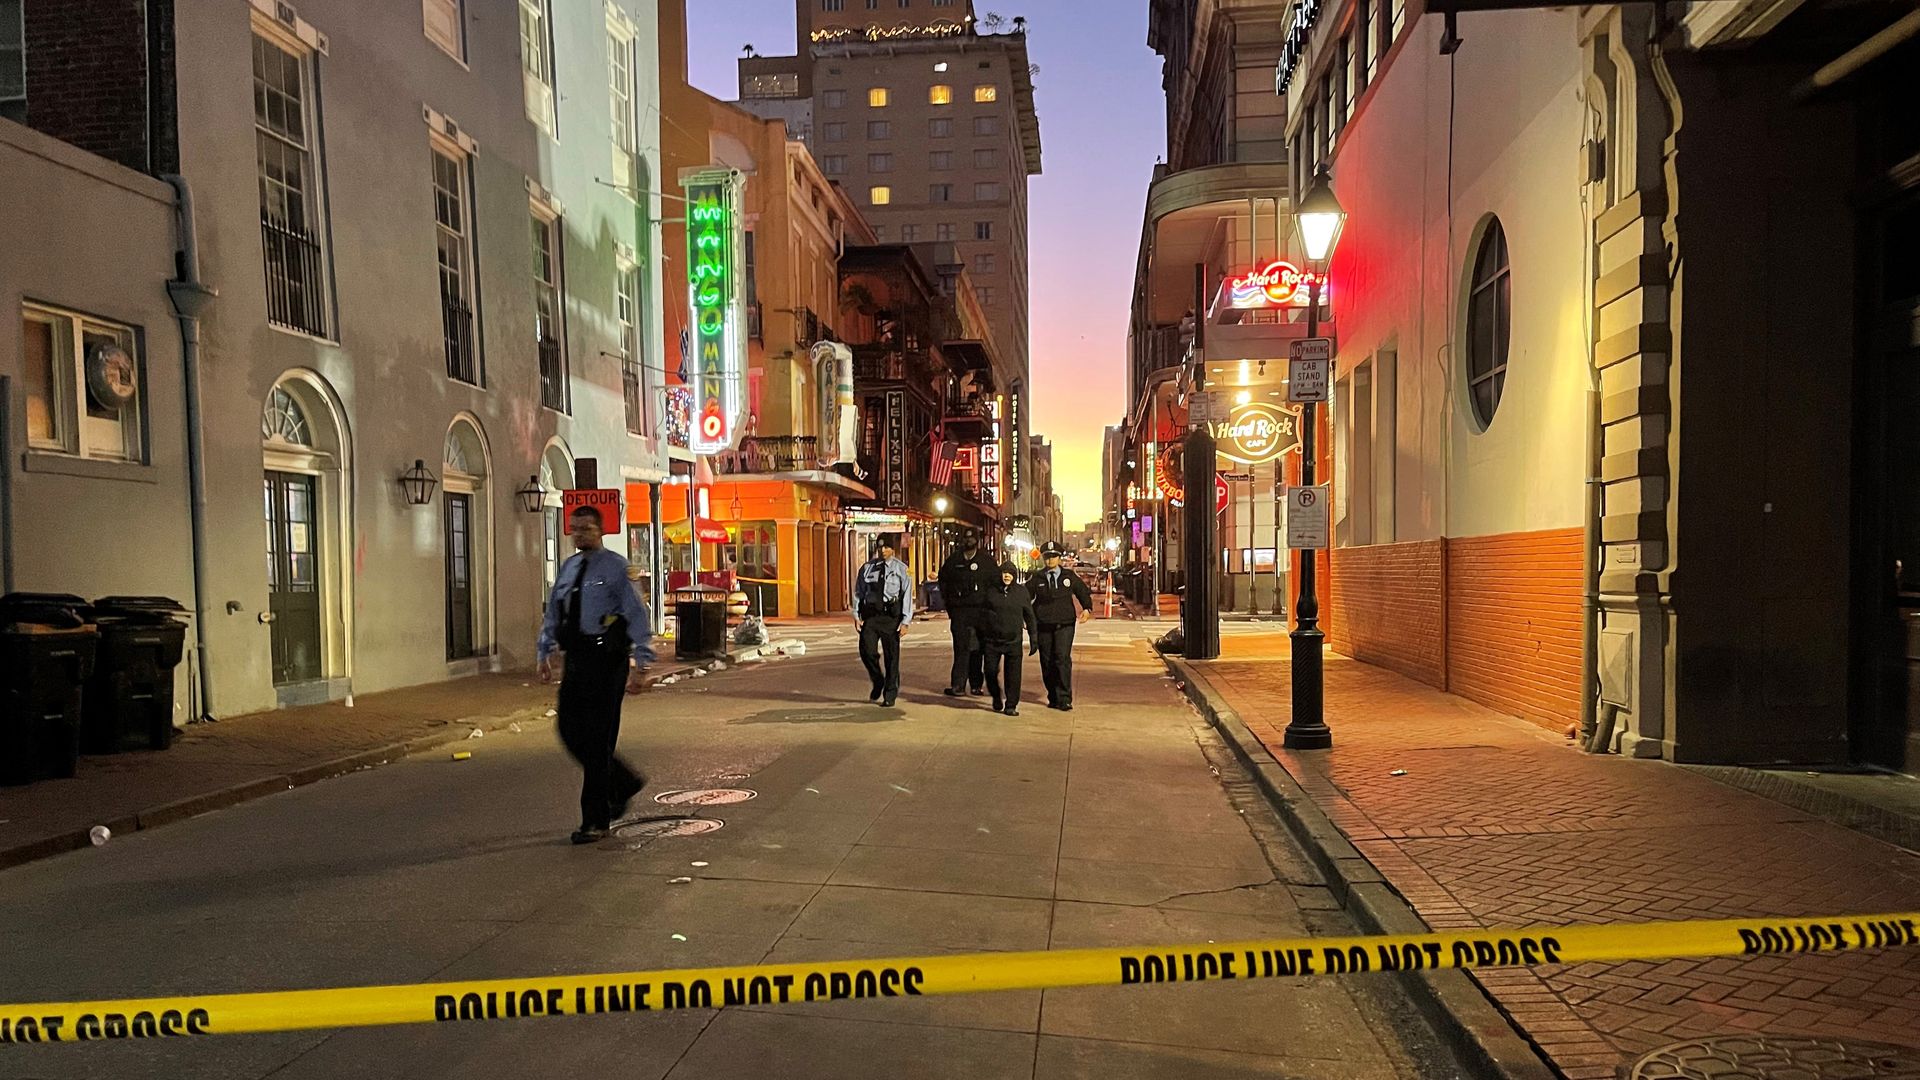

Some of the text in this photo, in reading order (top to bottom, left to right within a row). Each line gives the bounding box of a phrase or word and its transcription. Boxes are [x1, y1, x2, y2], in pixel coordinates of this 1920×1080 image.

[1247, 269, 1280, 288] Hard
[694, 191, 723, 437] MANGO MANGO
[1291, 344, 1329, 358] NO PARKING
[1302, 361, 1317, 371] CAB
[1297, 372, 1321, 381] STAND
[1217, 417, 1293, 438] Hard Rock
[1245, 439, 1267, 448] CAFE
[1156, 458, 1184, 500] BOURBO
[566, 492, 617, 506] DETOUR
[1120, 952, 1236, 984] POLICE
[1323, 945, 1370, 974] DO
[1378, 942, 1442, 972] NOT
[1452, 937, 1561, 968] CROSS
[435, 988, 563, 1021] POLICE
[663, 979, 712, 1009] DO
[724, 974, 794, 1006] NOT
[805, 967, 924, 1002] CROSS
